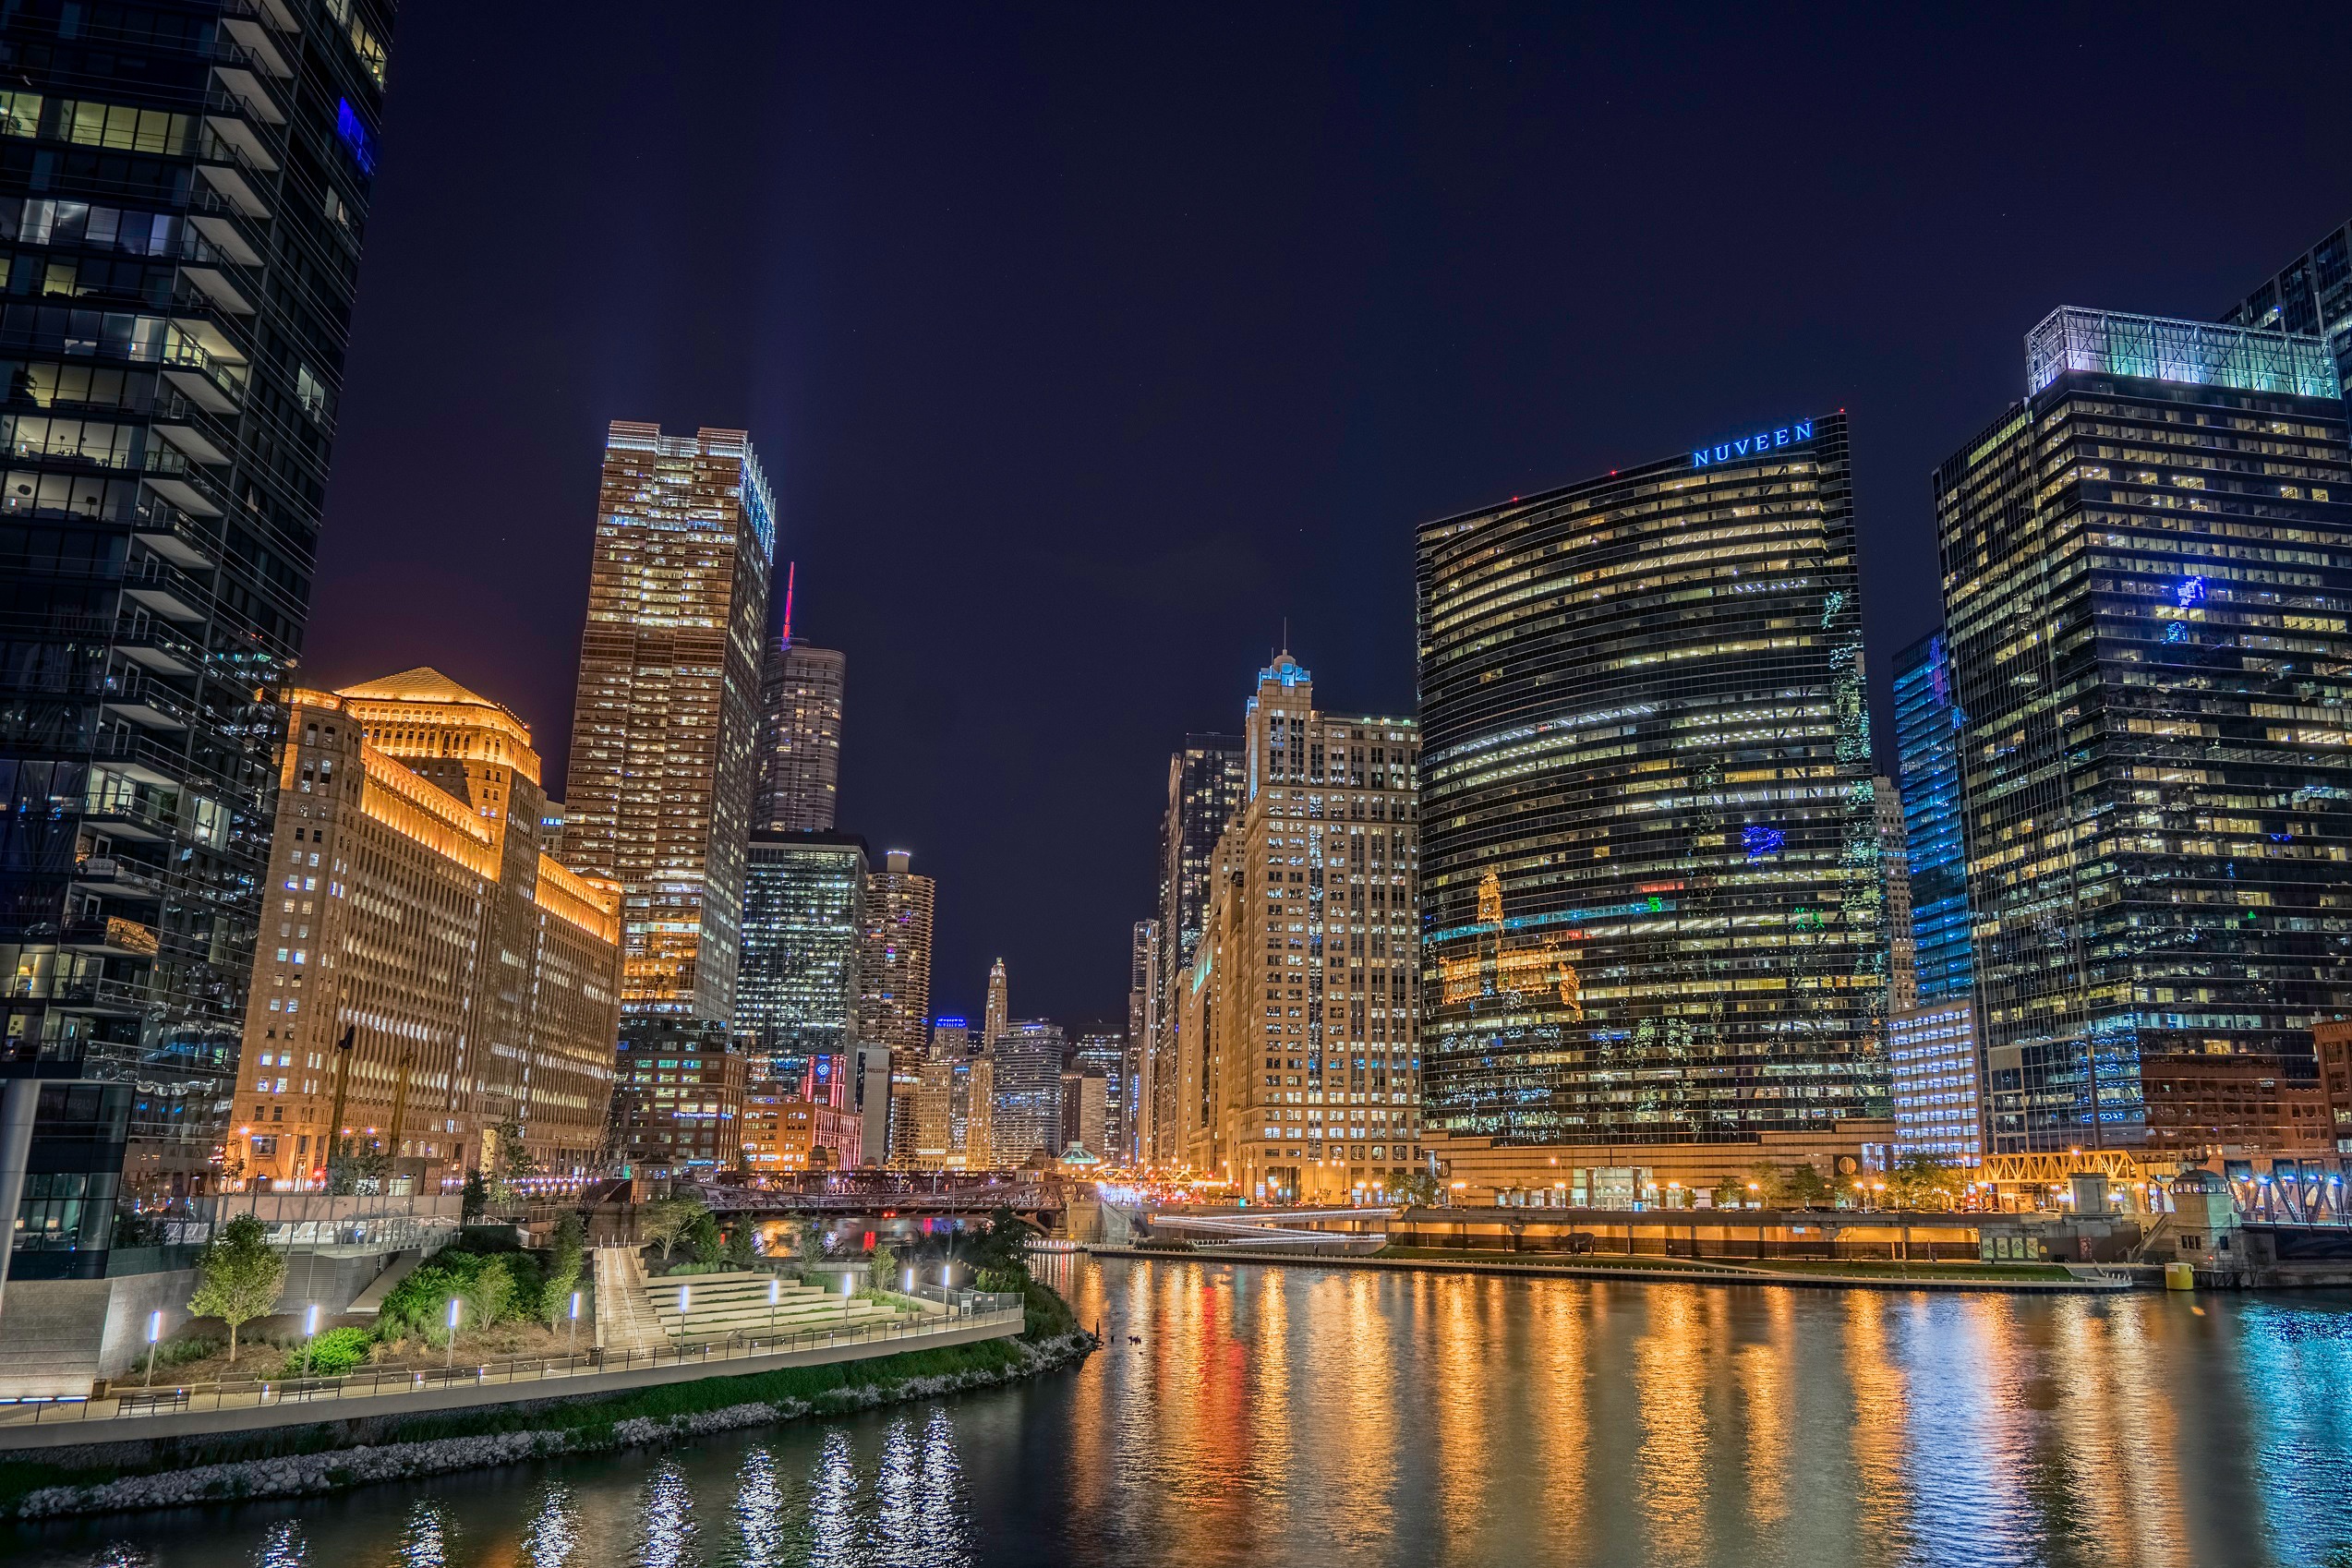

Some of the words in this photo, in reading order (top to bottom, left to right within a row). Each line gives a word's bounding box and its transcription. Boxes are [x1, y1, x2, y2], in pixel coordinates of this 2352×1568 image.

[1693, 422, 1812, 468] NUVEEN
[426, 1167, 442, 1178] WOLF
[424, 1178, 441, 1189] POINT
